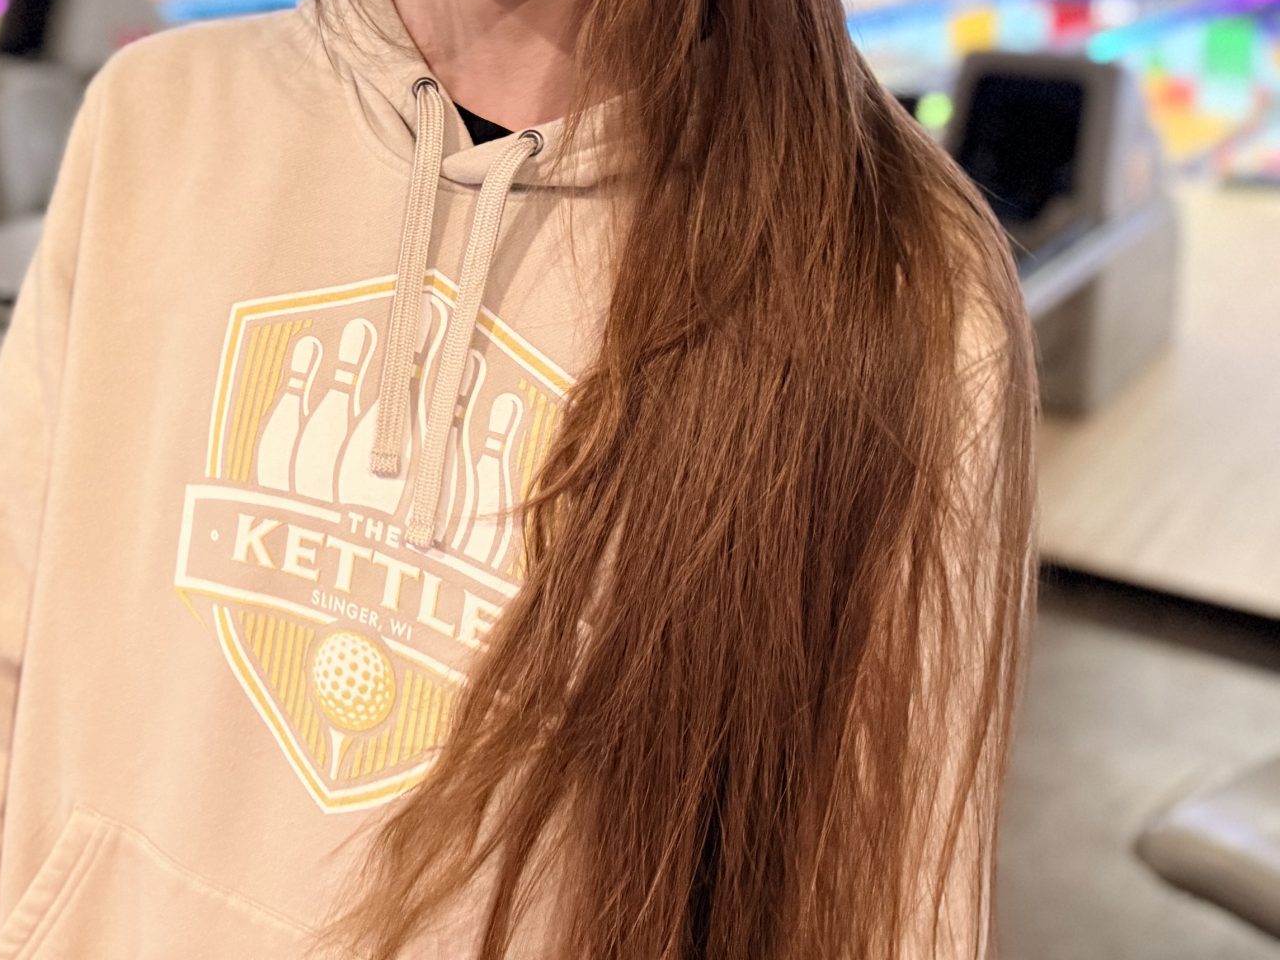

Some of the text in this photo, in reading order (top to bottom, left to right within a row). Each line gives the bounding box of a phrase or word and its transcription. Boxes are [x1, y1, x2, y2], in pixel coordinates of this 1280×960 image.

[348, 511, 402, 547] THE
[232, 513, 503, 650] KETTLE
[311, 589, 414, 641] SLINGER, WI
